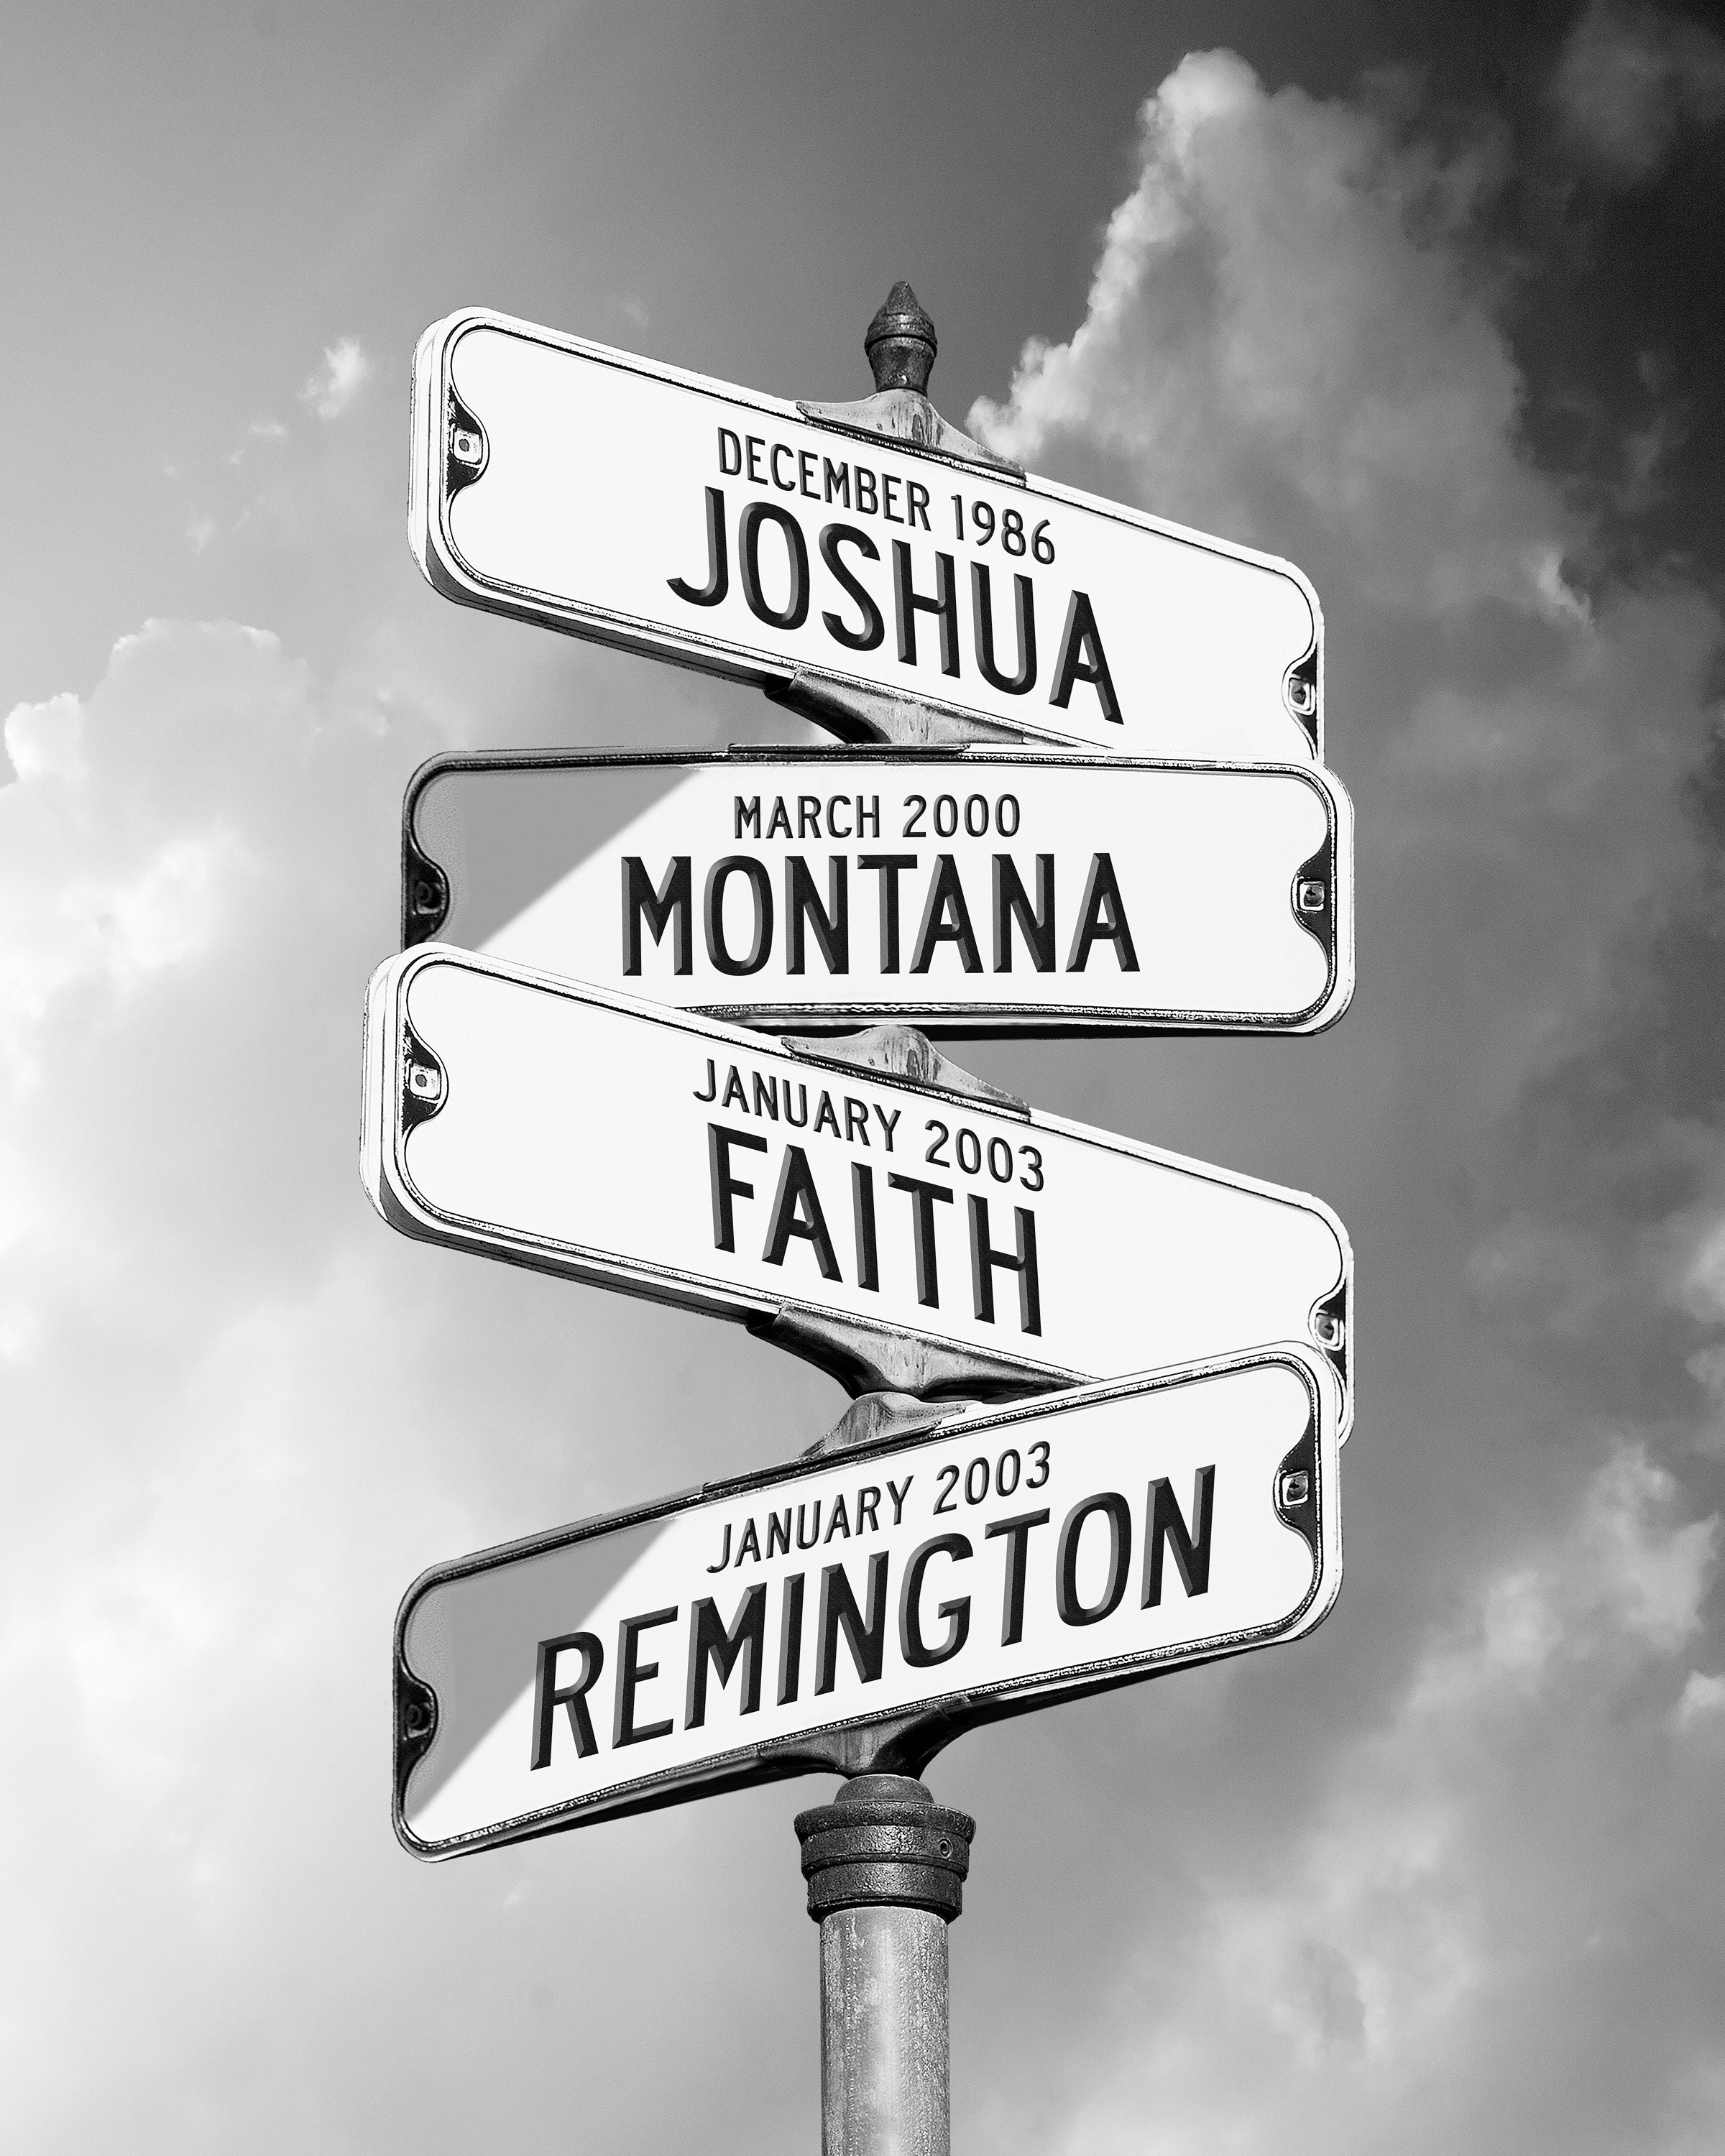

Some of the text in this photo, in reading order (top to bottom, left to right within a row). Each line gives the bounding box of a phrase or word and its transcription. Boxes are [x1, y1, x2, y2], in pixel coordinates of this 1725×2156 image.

[718, 427, 1054, 564] DECEMBER 1986
[666, 486, 1124, 725] JOSHUA
[735, 794, 1020, 839] MARCH 2000
[622, 853, 1140, 976] MONTANA
[693, 1059, 1044, 1192] JANUARY 2003
[708, 1123, 1041, 1337] FAITH
[707, 1441, 1050, 1573] JANUARY 2003
[530, 1465, 1215, 1771] REMINGTON
